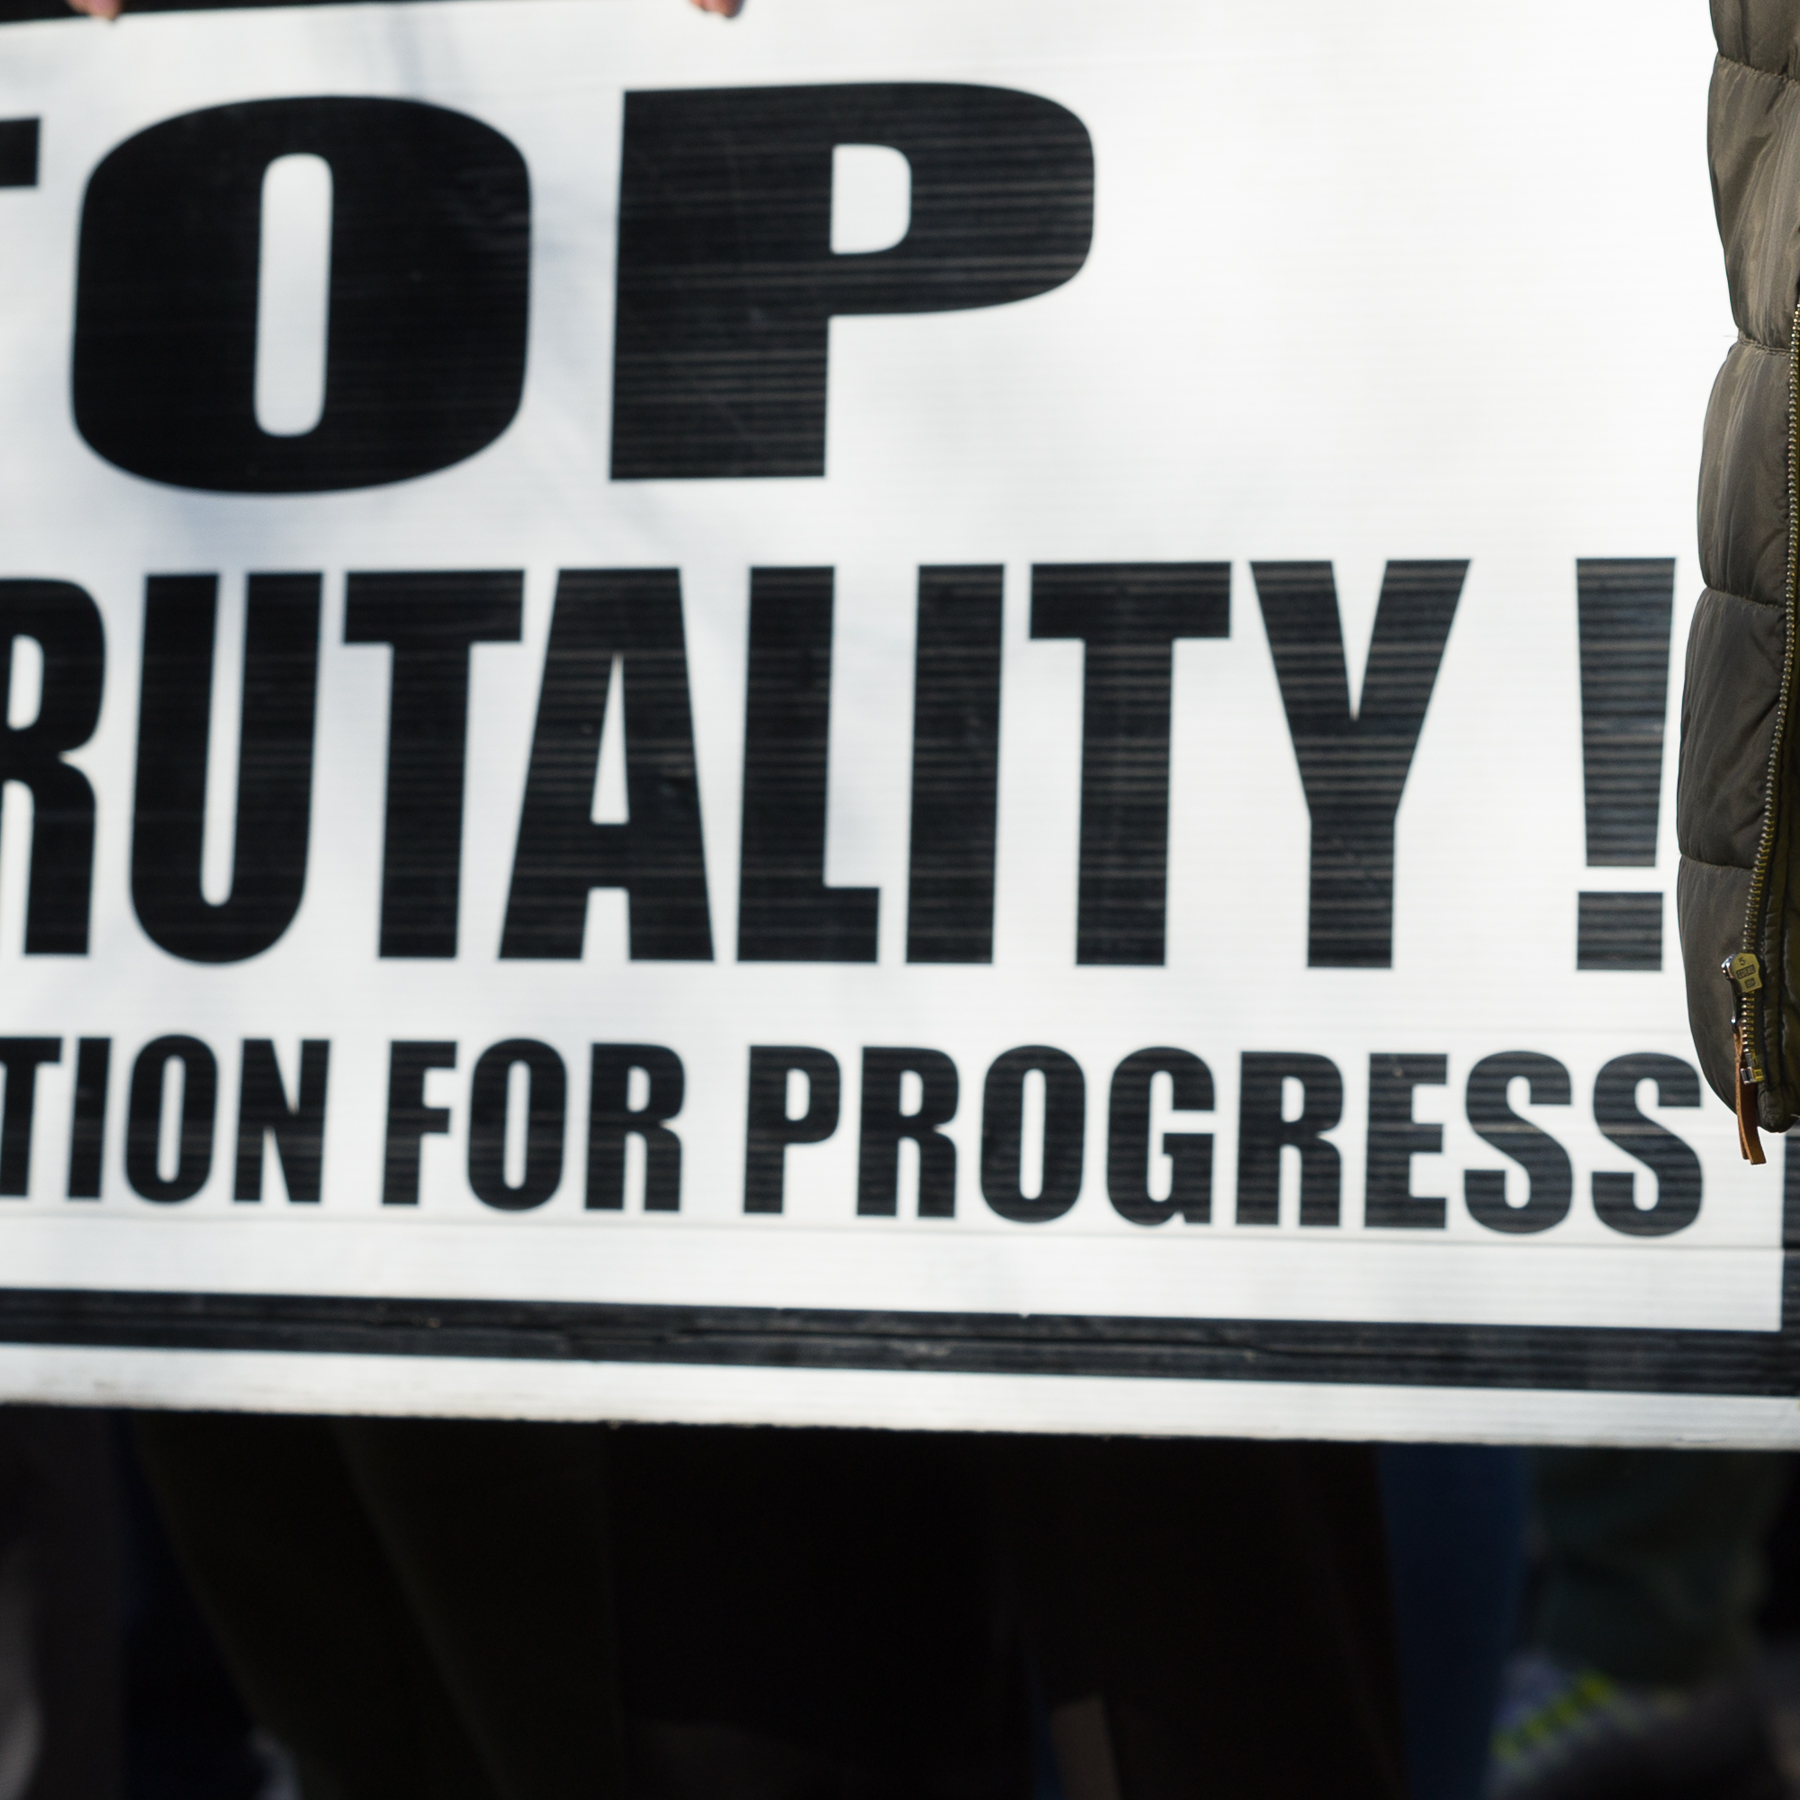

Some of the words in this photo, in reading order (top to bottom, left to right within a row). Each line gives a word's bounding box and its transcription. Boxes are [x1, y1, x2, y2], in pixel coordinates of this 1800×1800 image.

[1576, 557, 1676, 971] !
[383, 1039, 684, 1211] FOR
[744, 1046, 1702, 1237] PROGRESS
